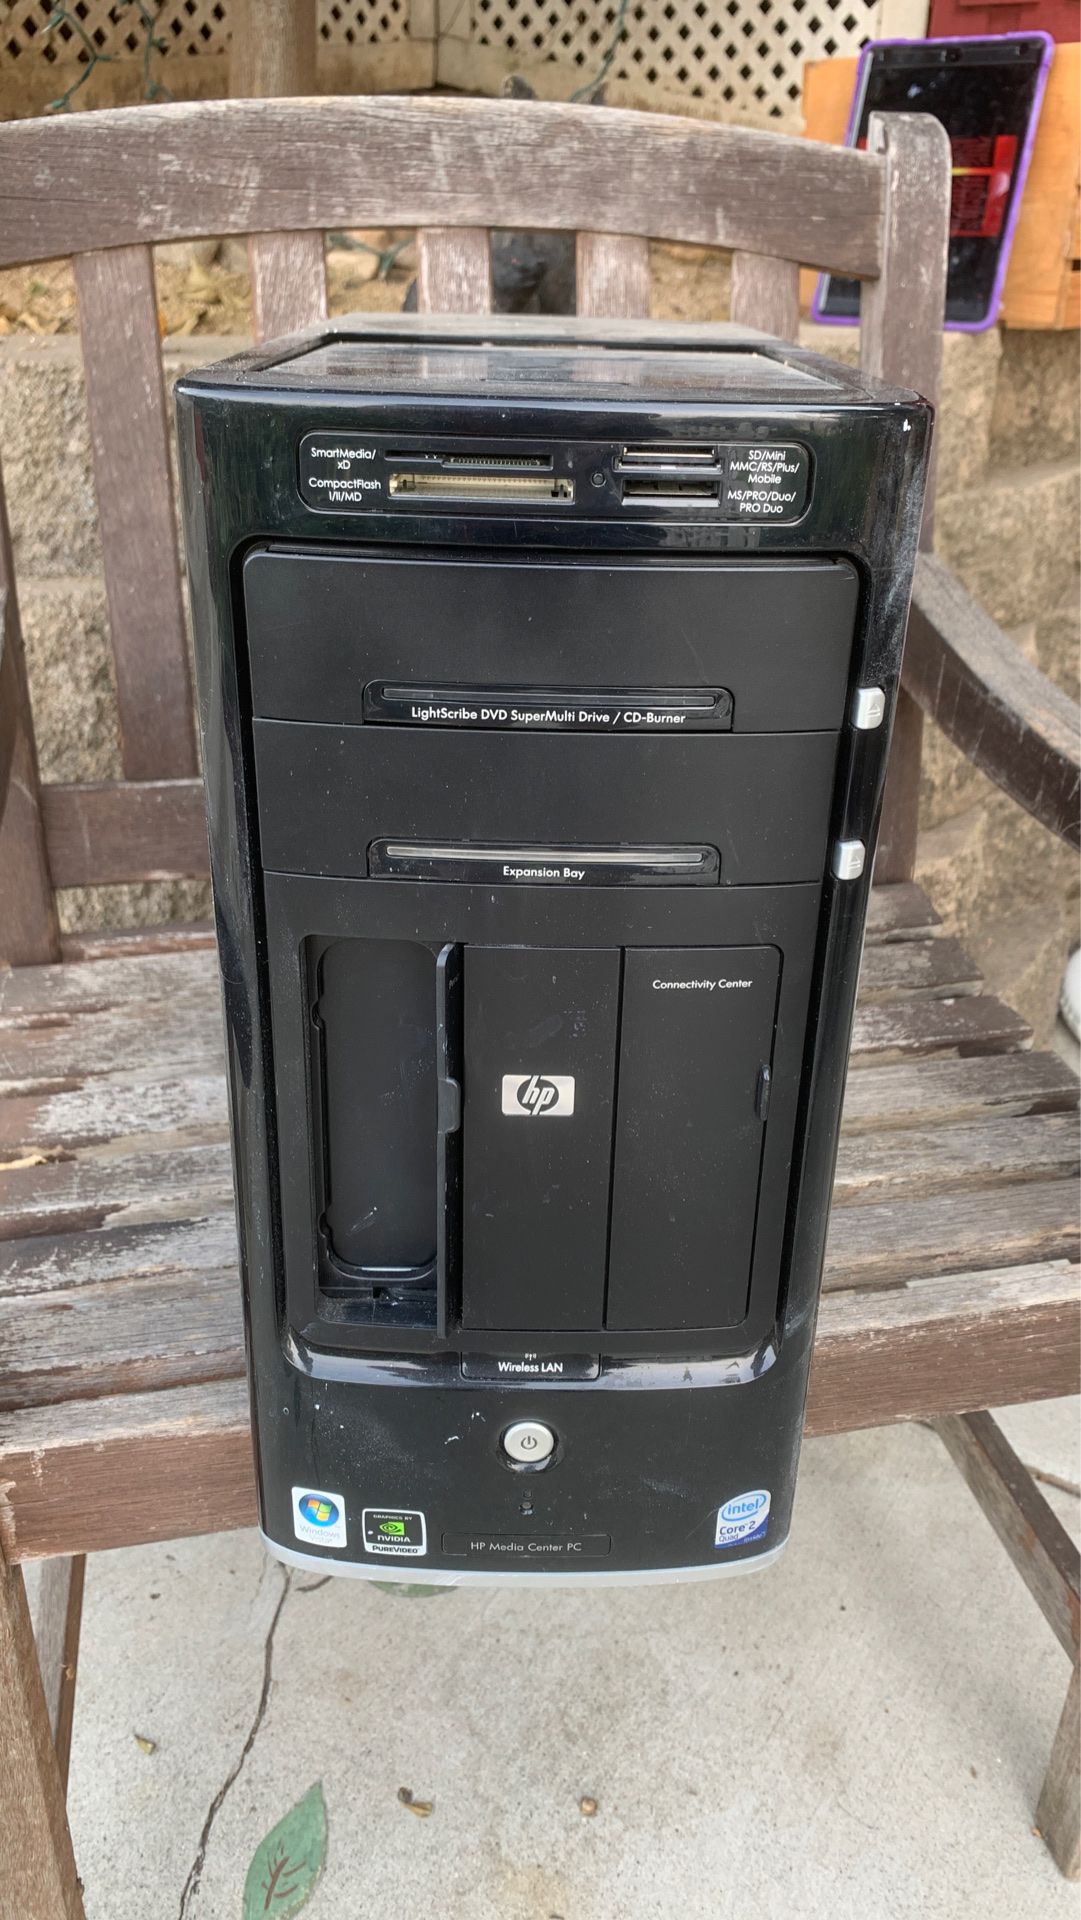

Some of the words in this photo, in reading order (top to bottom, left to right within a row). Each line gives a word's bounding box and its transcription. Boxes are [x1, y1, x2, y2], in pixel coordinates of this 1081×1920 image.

[311, 447, 377, 461] SmartMedia/
[748, 449, 786, 461] SD/Mini
[337, 460, 351, 470] xD
[729, 461, 800, 474] MMC/RS/Plus/
[308, 477, 382, 491] CompactFlash
[748, 473, 782, 484] Mobile
[328, 491, 363, 502] I/II/MD
[727, 490, 797, 502] MS/PRO/Duo/
[739, 502, 761, 513] PRO
[763, 502, 784, 514] Duo
[411, 705, 478, 722] LightScribe
[480, 708, 508, 721] DVD
[510, 709, 576, 724] SuperMulti
[578, 710, 610, 723] Drive
[623, 711, 686, 724] CD-Burner
[503, 865, 560, 880] Expansion
[563, 867, 585, 880] Bay
[652, 979, 716, 991] Connectivity
[718, 979, 753, 989] Center
[498, 1361, 539, 1372] Wireless
[541, 1362, 564, 1373] LAN
[727, 1498, 759, 1515] intel
[719, 1525, 746, 1536] Core
[748, 1520, 756, 1530] 2
[470, 1542, 486, 1551] HP
[489, 1542, 524, 1551] Media
[528, 1543, 564, 1552] Center
[567, 1542, 582, 1551] PC
